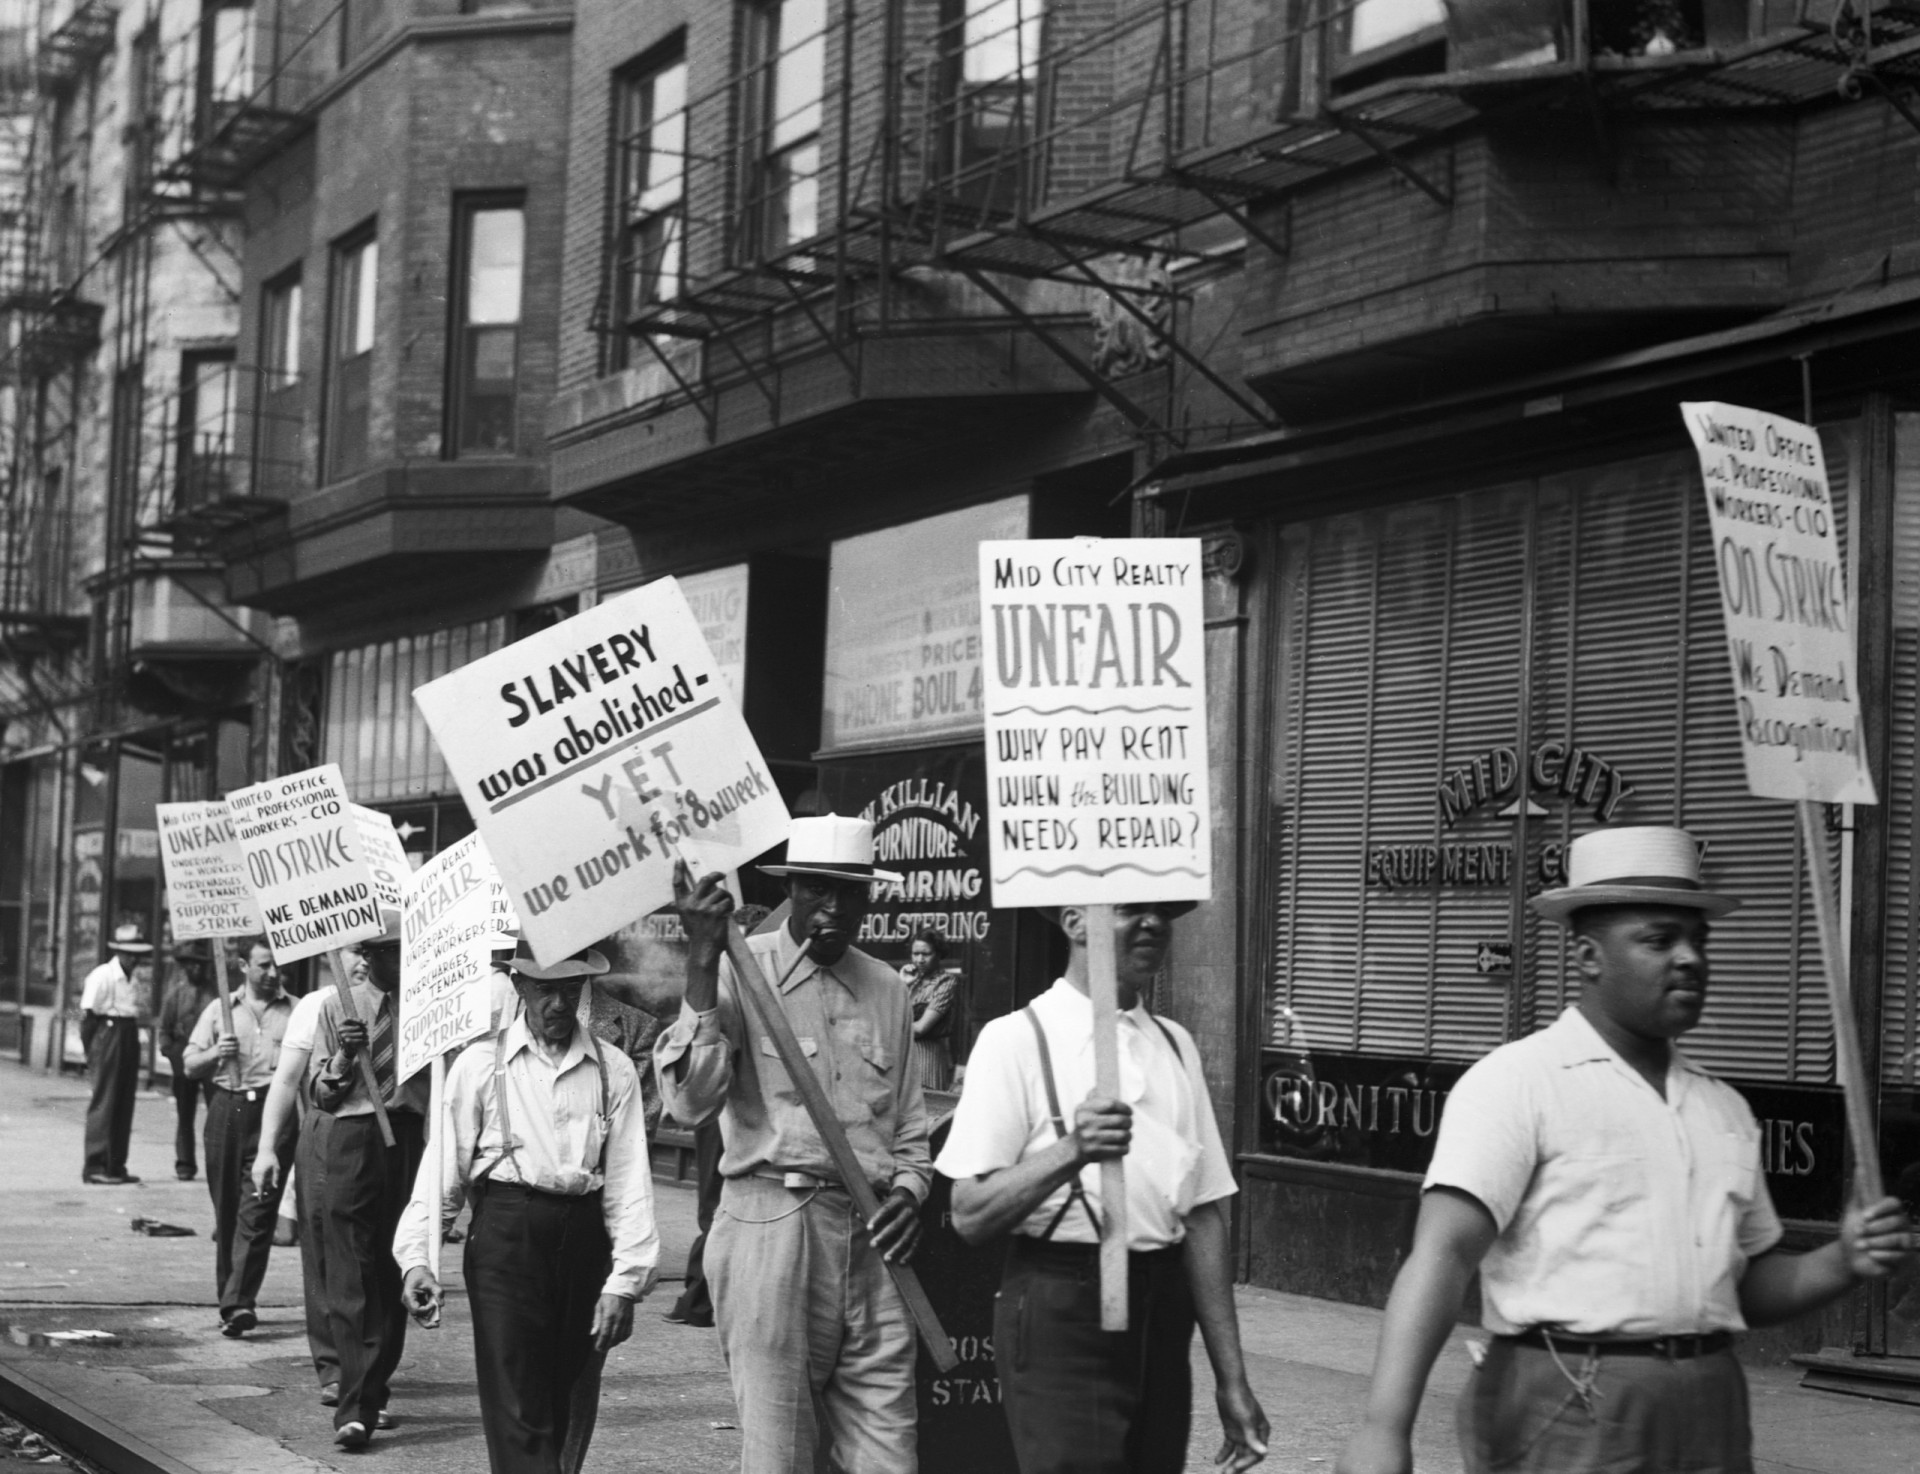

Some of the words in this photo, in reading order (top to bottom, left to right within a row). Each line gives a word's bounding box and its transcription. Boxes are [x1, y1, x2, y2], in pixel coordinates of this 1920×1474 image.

[1765, 424, 1816, 467] OFFICE
[994, 557, 1041, 589] MID
[1053, 557, 1102, 587] CITY
[1113, 557, 1190, 587] REALTY
[1766, 543, 1846, 632] STRIKE
[991, 603, 1193, 689] UNFAIR
[500, 624, 658, 728] SLAVERY
[997, 728, 1048, 762] WHY
[1060, 727, 1106, 761] PAY
[1121, 725, 1190, 761] RENT
[231, 789, 273, 810] UNITED
[281, 774, 328, 796] OFFICE
[478, 752, 547, 803] was
[581, 741, 683, 821] YET
[997, 775, 1060, 807] WHEN
[1070, 779, 1099, 808] the
[1102, 772, 1194, 805] BUILDING
[1439, 746, 1518, 827] MID
[1531, 743, 1636, 821] CITY
[241, 815, 298, 840] WORKERS
[311, 800, 341, 820] CIO
[257, 787, 339, 818] PROFESSIONAL
[881, 778, 981, 840] KILLIAN
[167, 818, 237, 854] UNFAIR
[247, 848, 279, 889] ON
[276, 826, 355, 882] STRIKE
[872, 817, 958, 862] FURNITURE
[1002, 818, 1079, 851] NEEDS
[1098, 811, 1200, 861] REPAIR?
[404, 889, 419, 910] MID
[421, 867, 439, 894] CITY
[441, 835, 478, 873] REALTY
[522, 875, 571, 917] we
[574, 826, 652, 891] work
[649, 809, 690, 860] for
[869, 868, 982, 903] PAIRING
[1365, 845, 1512, 890] EQUIPMENT
[176, 902, 240, 917] SUPPORT
[197, 916, 252, 931] STRIKE
[266, 904, 293, 925] WE
[299, 882, 369, 917] DEMAND
[271, 897, 386, 950] RECOGNITION!
[405, 861, 483, 946] UNFAIR
[857, 911, 990, 943] HOLSTERING
[433, 920, 486, 960] WORKERS
[405, 949, 469, 1003] OVERCHARGES
[429, 960, 478, 999] TENANTS
[402, 991, 466, 1052] SUPPORT
[422, 1010, 473, 1060] STRIKE
[1274, 1076, 1450, 1137] FURNITU
